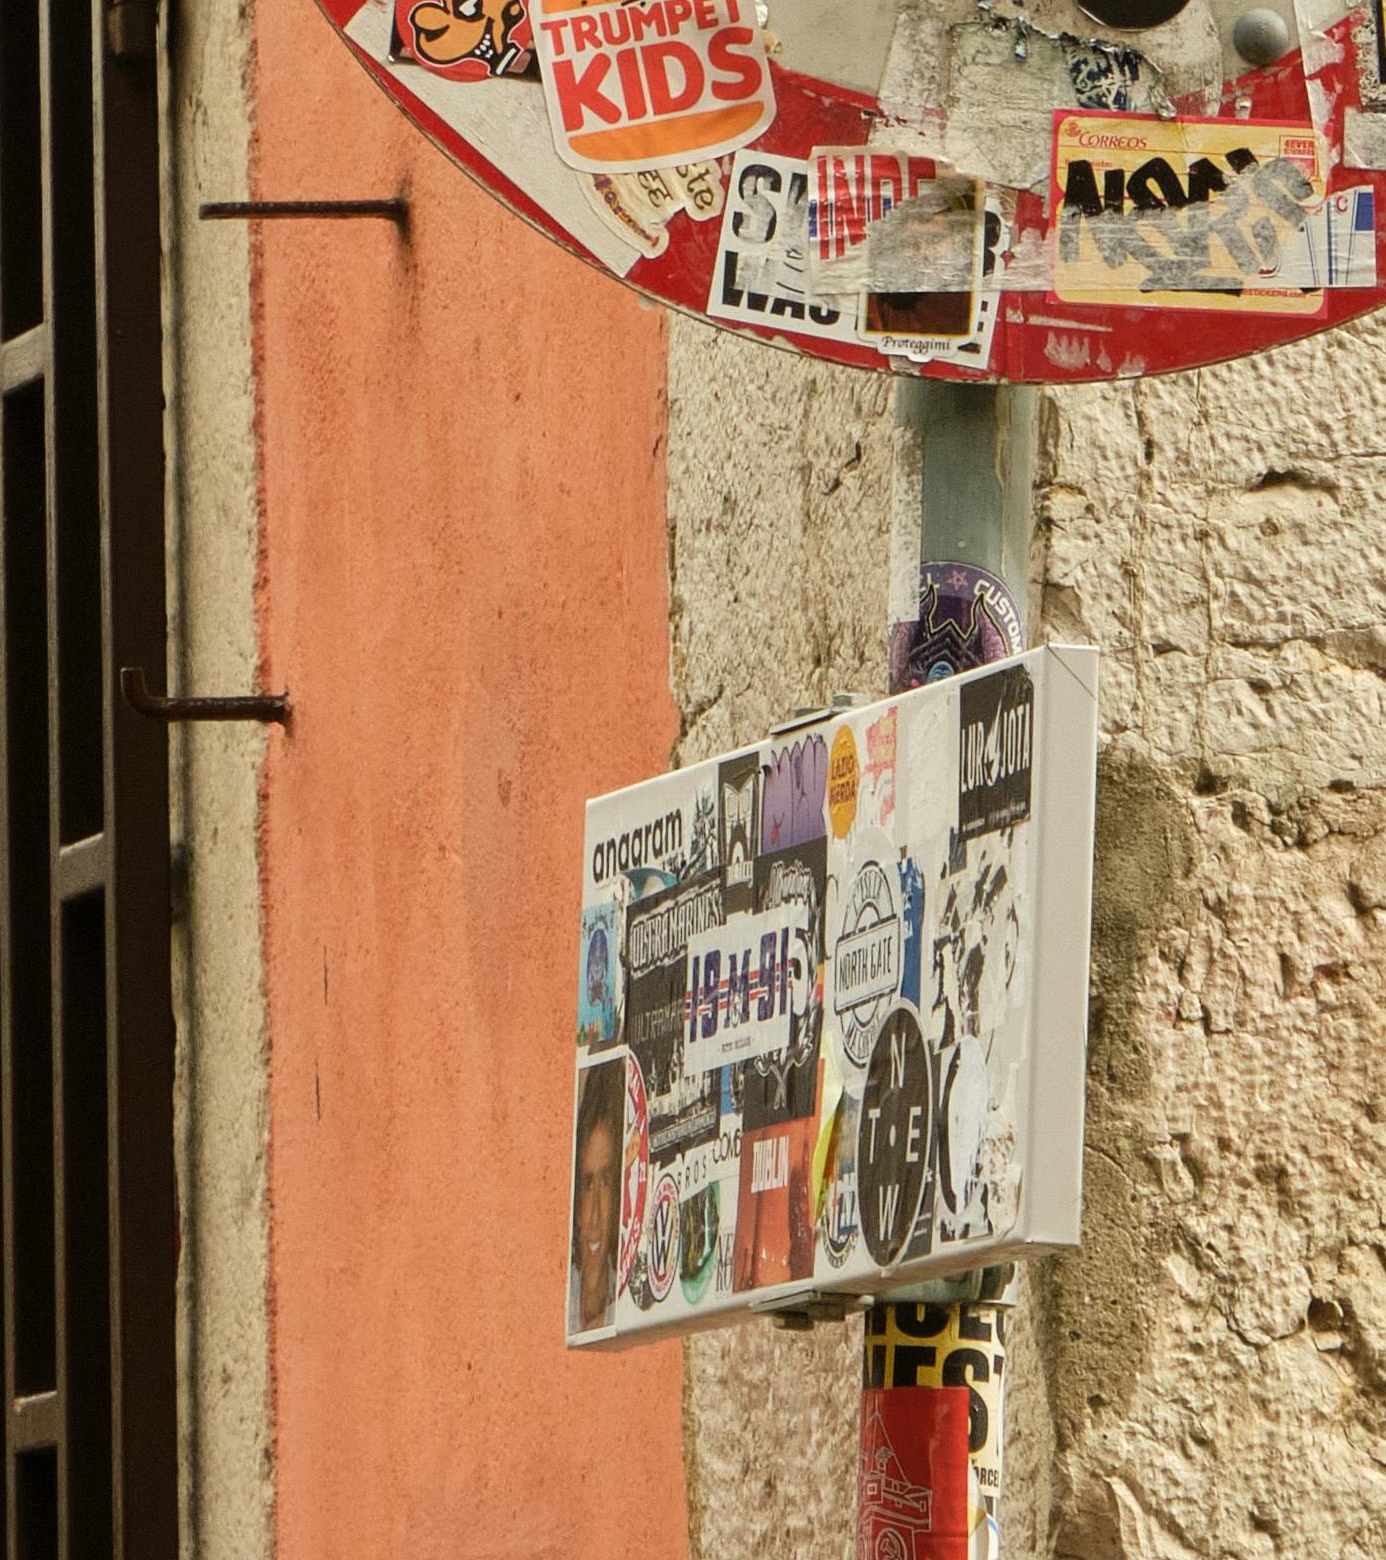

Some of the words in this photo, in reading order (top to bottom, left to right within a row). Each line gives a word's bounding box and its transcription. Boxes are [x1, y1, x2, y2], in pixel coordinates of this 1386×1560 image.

[551, 26, 763, 133] KIDS
[1078, 131, 1148, 149] CORREOS
[881, 336, 952, 355] Proteggimi
[592, 808, 683, 884] anagram
[839, 947, 869, 993] NORTH
[869, 935, 893, 980] GATE
[751, 1135, 790, 1194] DUBLIN
